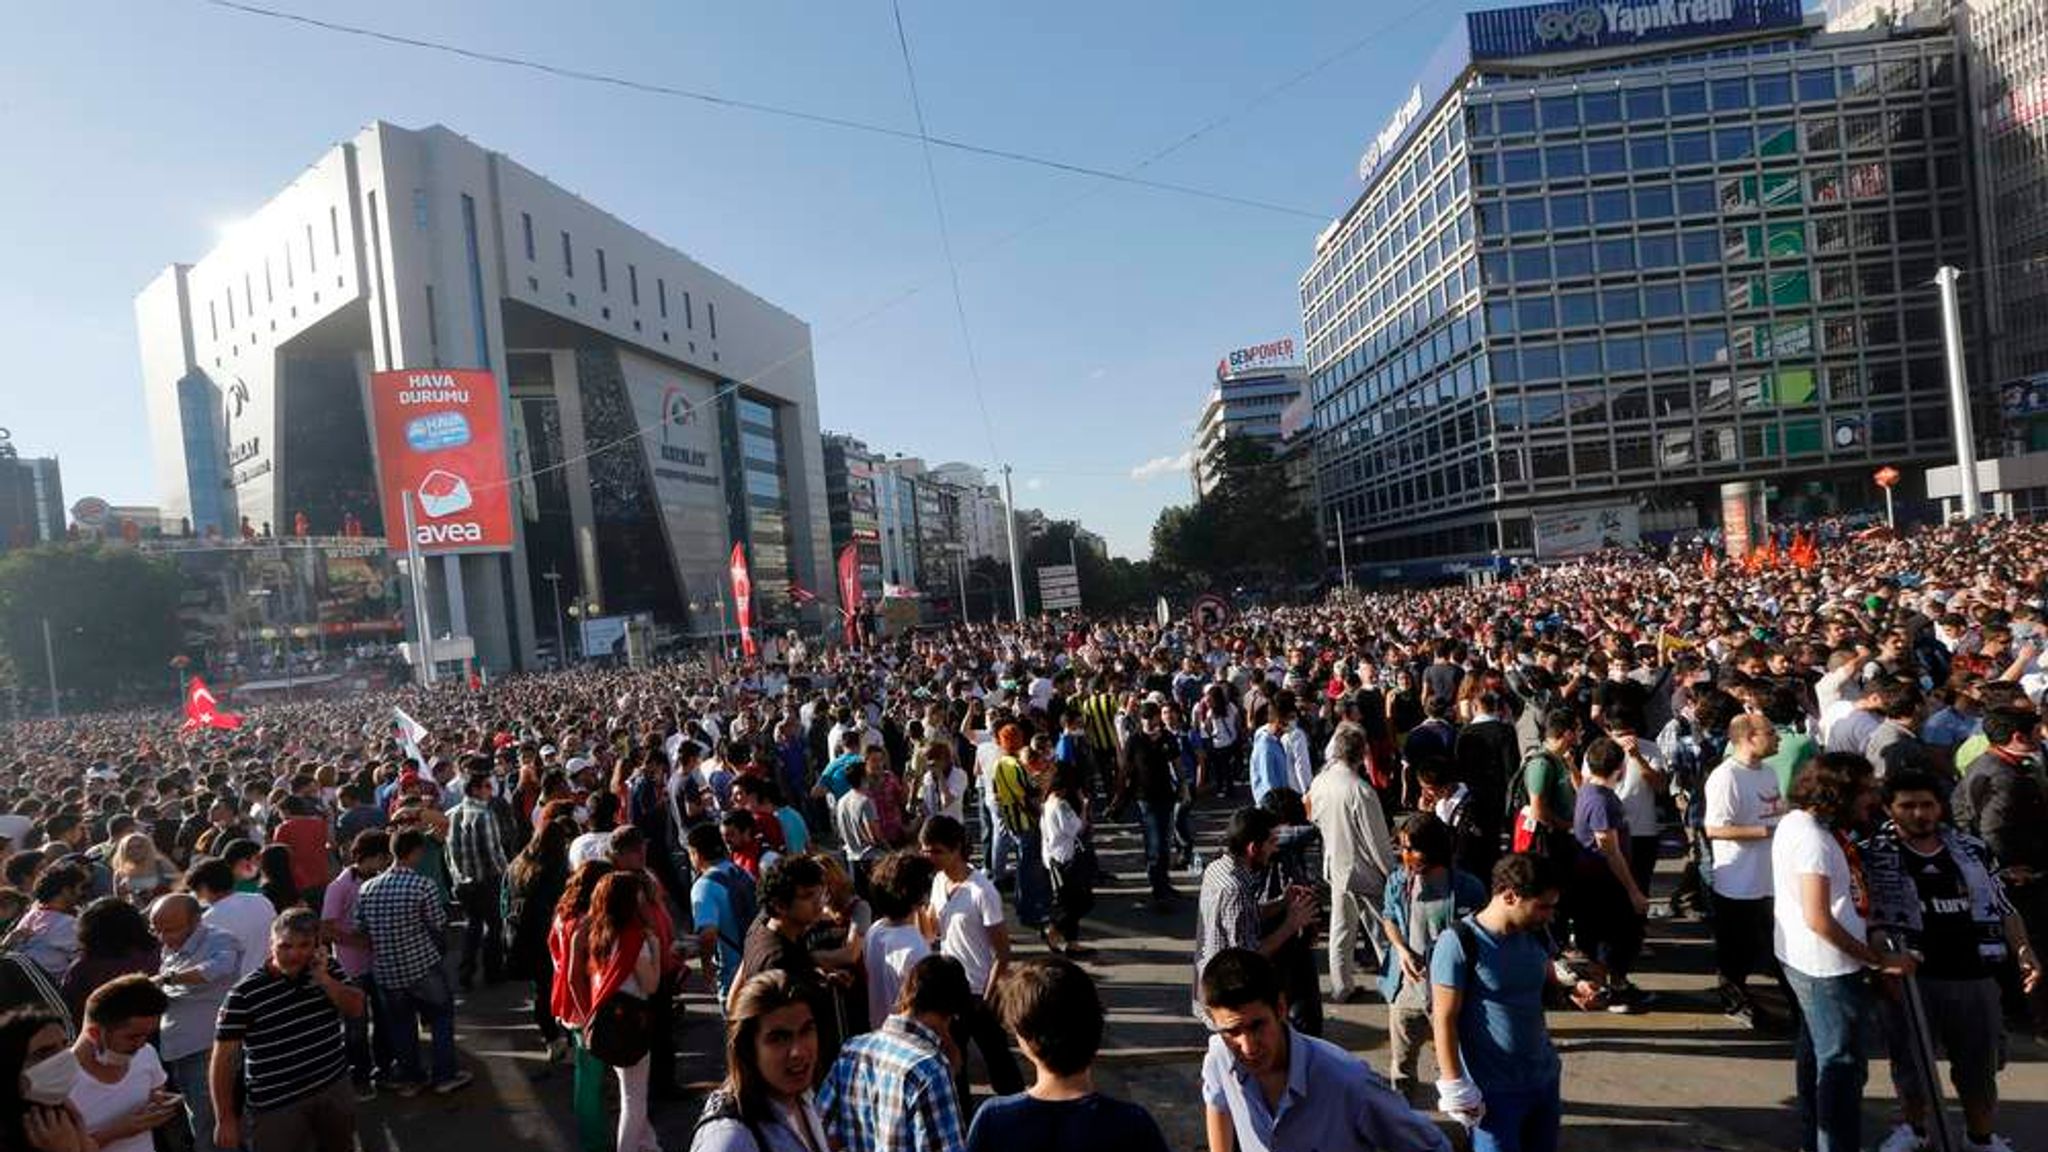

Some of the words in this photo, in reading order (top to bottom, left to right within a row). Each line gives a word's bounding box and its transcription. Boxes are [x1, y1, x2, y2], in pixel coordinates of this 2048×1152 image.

[409, 375, 455, 388] HAVA
[399, 391, 469, 405] DURUMU
[417, 522, 481, 544] avea
